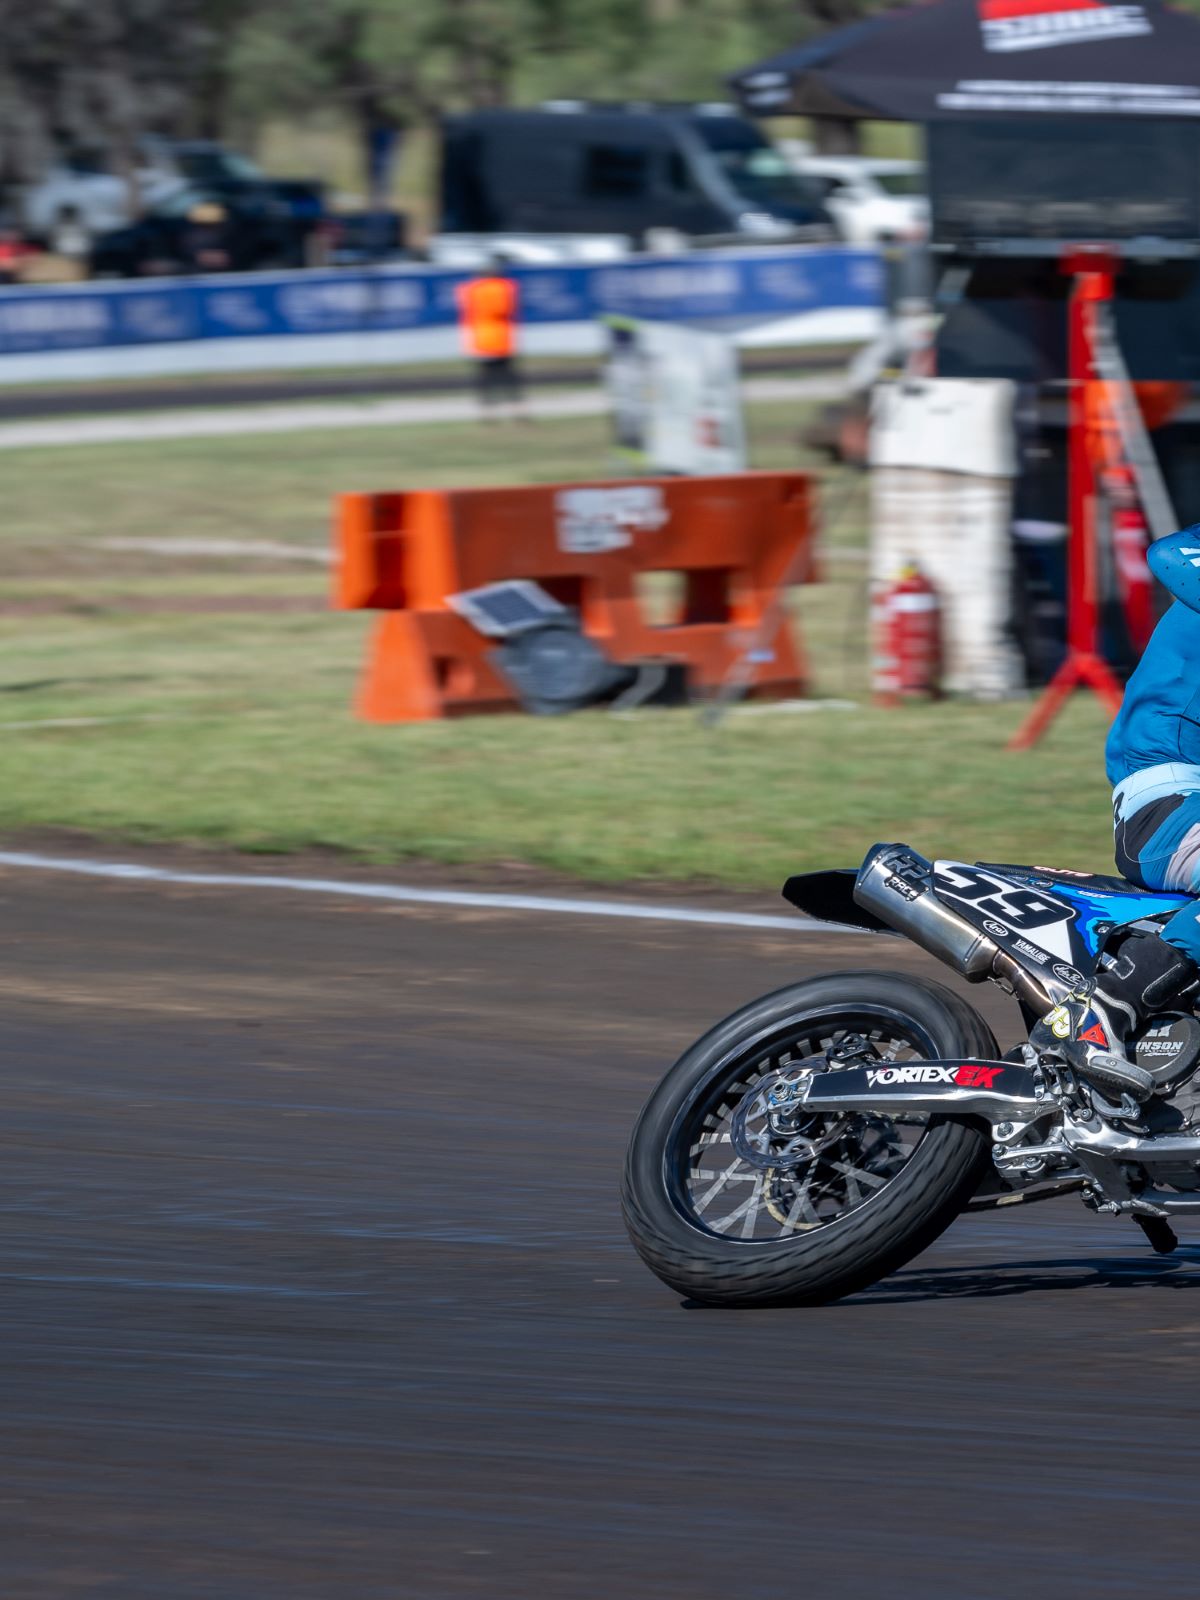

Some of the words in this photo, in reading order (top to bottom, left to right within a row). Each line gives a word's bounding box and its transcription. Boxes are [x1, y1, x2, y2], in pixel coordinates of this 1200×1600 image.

[933, 864, 1075, 931] 59
[987, 921, 1007, 936] Arai
[1015, 938, 1050, 963] YAMALUBE
[1135, 1041, 1184, 1050] INSON
[866, 1066, 959, 1088] VORTEX
